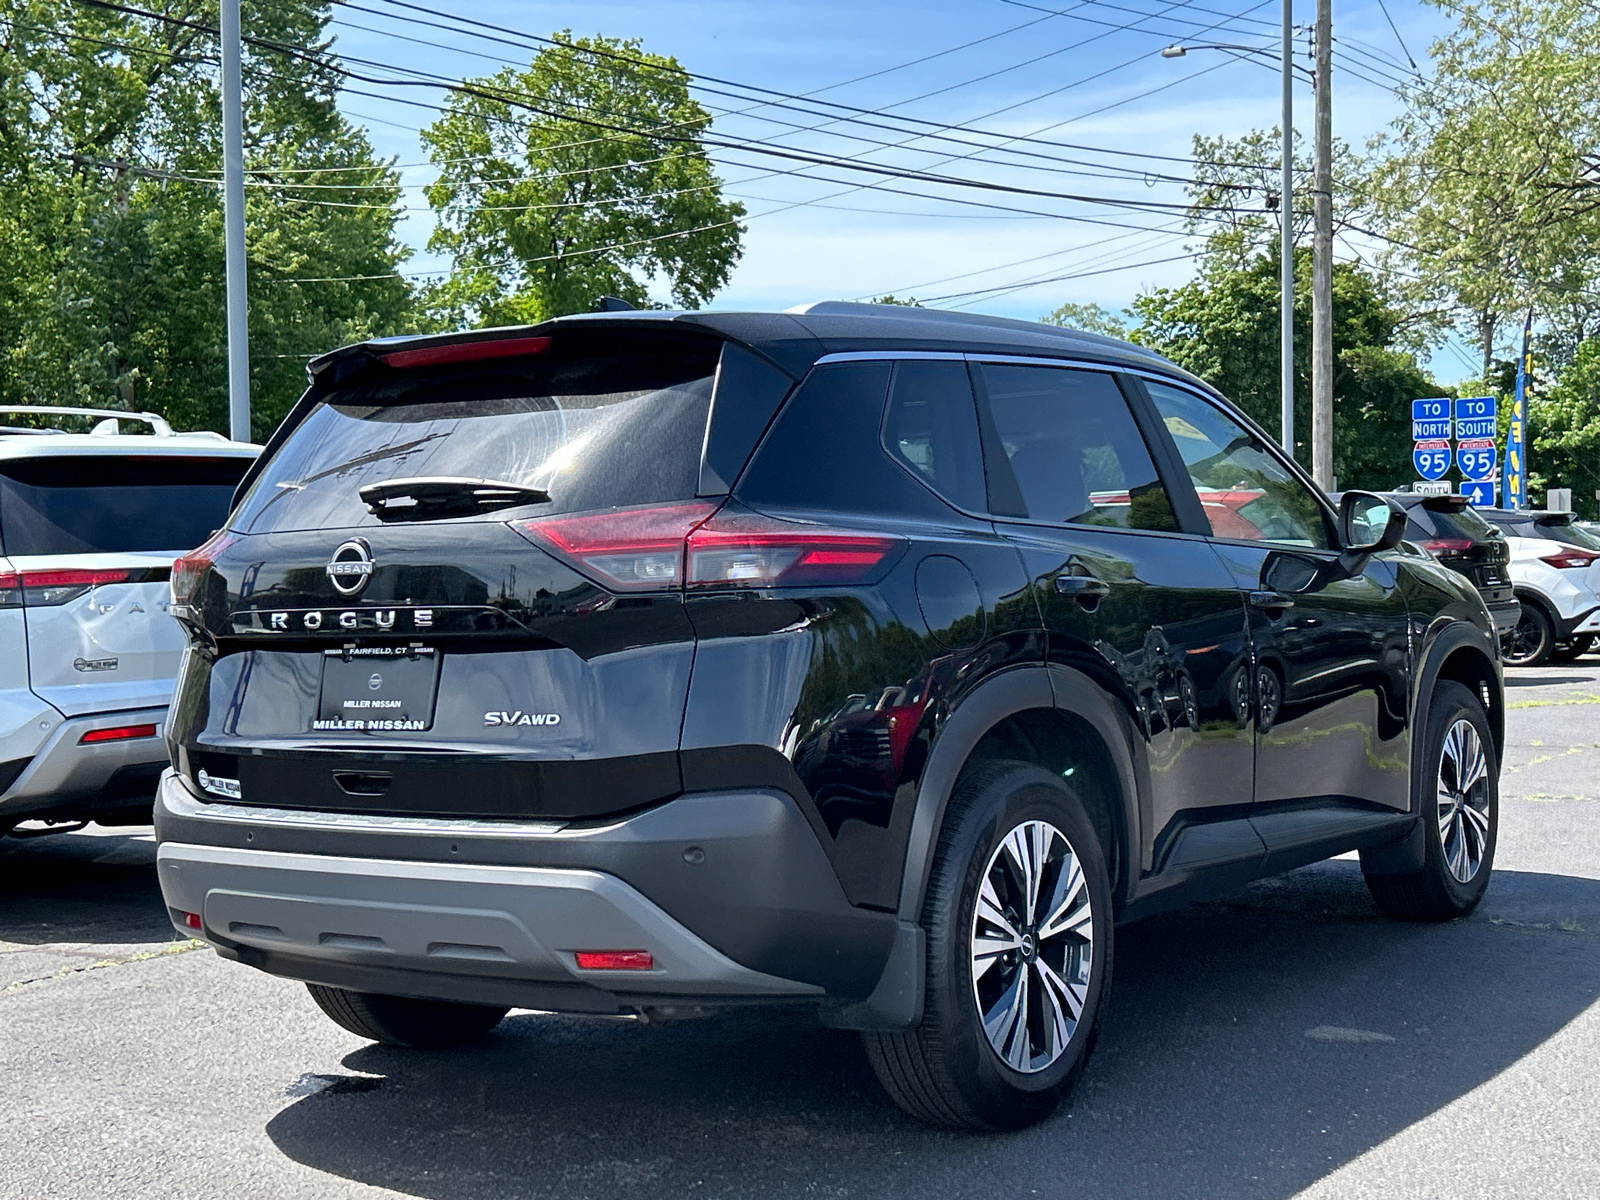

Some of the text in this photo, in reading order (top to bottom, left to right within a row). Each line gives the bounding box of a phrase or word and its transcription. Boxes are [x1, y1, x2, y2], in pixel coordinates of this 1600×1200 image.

[1423, 403, 1441, 415] TO
[1466, 402, 1485, 414] TO
[1414, 422, 1450, 436] NORTH
[1458, 421, 1494, 436] SOUTH
[1419, 454, 1445, 473] 95
[1463, 453, 1490, 472] 95
[326, 563, 372, 575] NISSAN
[271, 609, 433, 629] ROGUE
[372, 700, 402, 708] NISSAN
[313, 720, 424, 730] MILLER NISSAN
